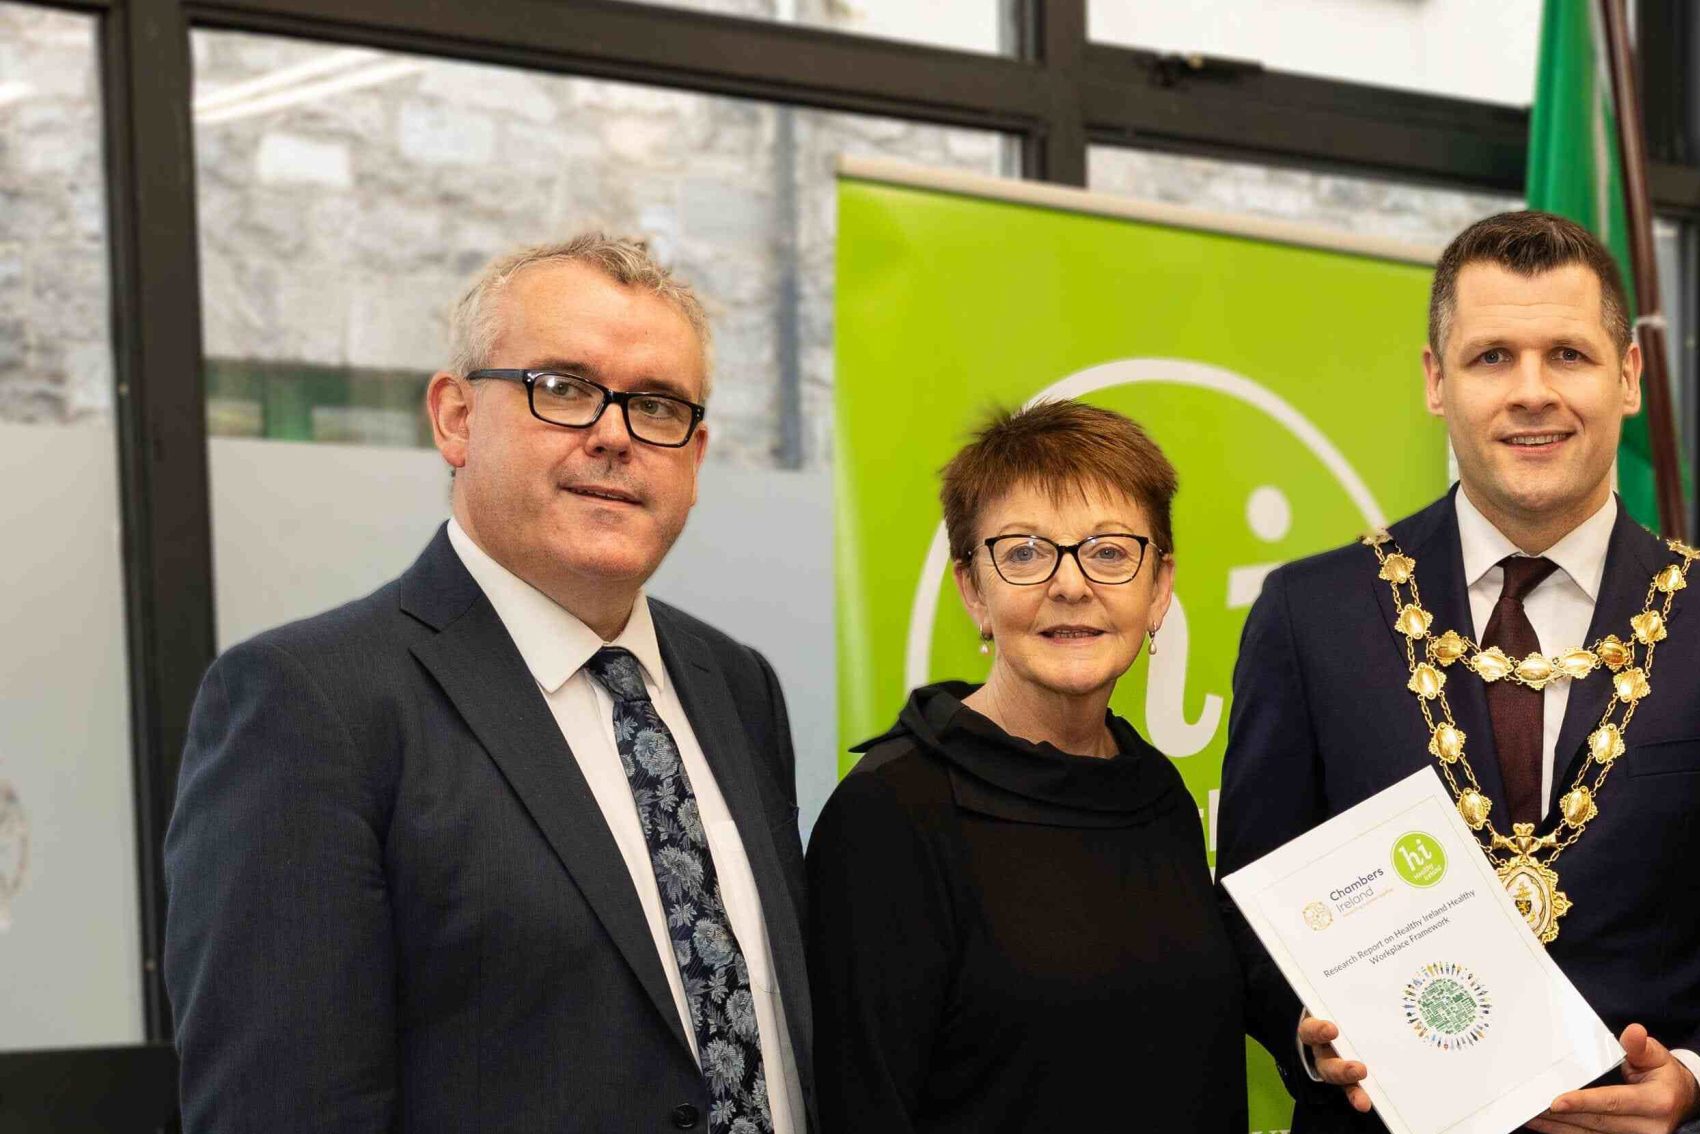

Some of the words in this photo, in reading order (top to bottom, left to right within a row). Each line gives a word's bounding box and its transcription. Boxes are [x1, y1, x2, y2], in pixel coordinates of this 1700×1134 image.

[1398, 838, 1433, 872] hi
[1329, 867, 1385, 902] Chambers
[1336, 886, 1375, 913] Ireland
[1323, 954, 1359, 978] Research
[1357, 940, 1384, 960] Report
[1384, 934, 1395, 944] on
[1394, 920, 1423, 939] Healthy
[1422, 904, 1448, 922] Ireland
[1448, 889, 1476, 909] Healthy
[1369, 938, 1410, 966] Workplace
[1409, 916, 1451, 943] Framework
